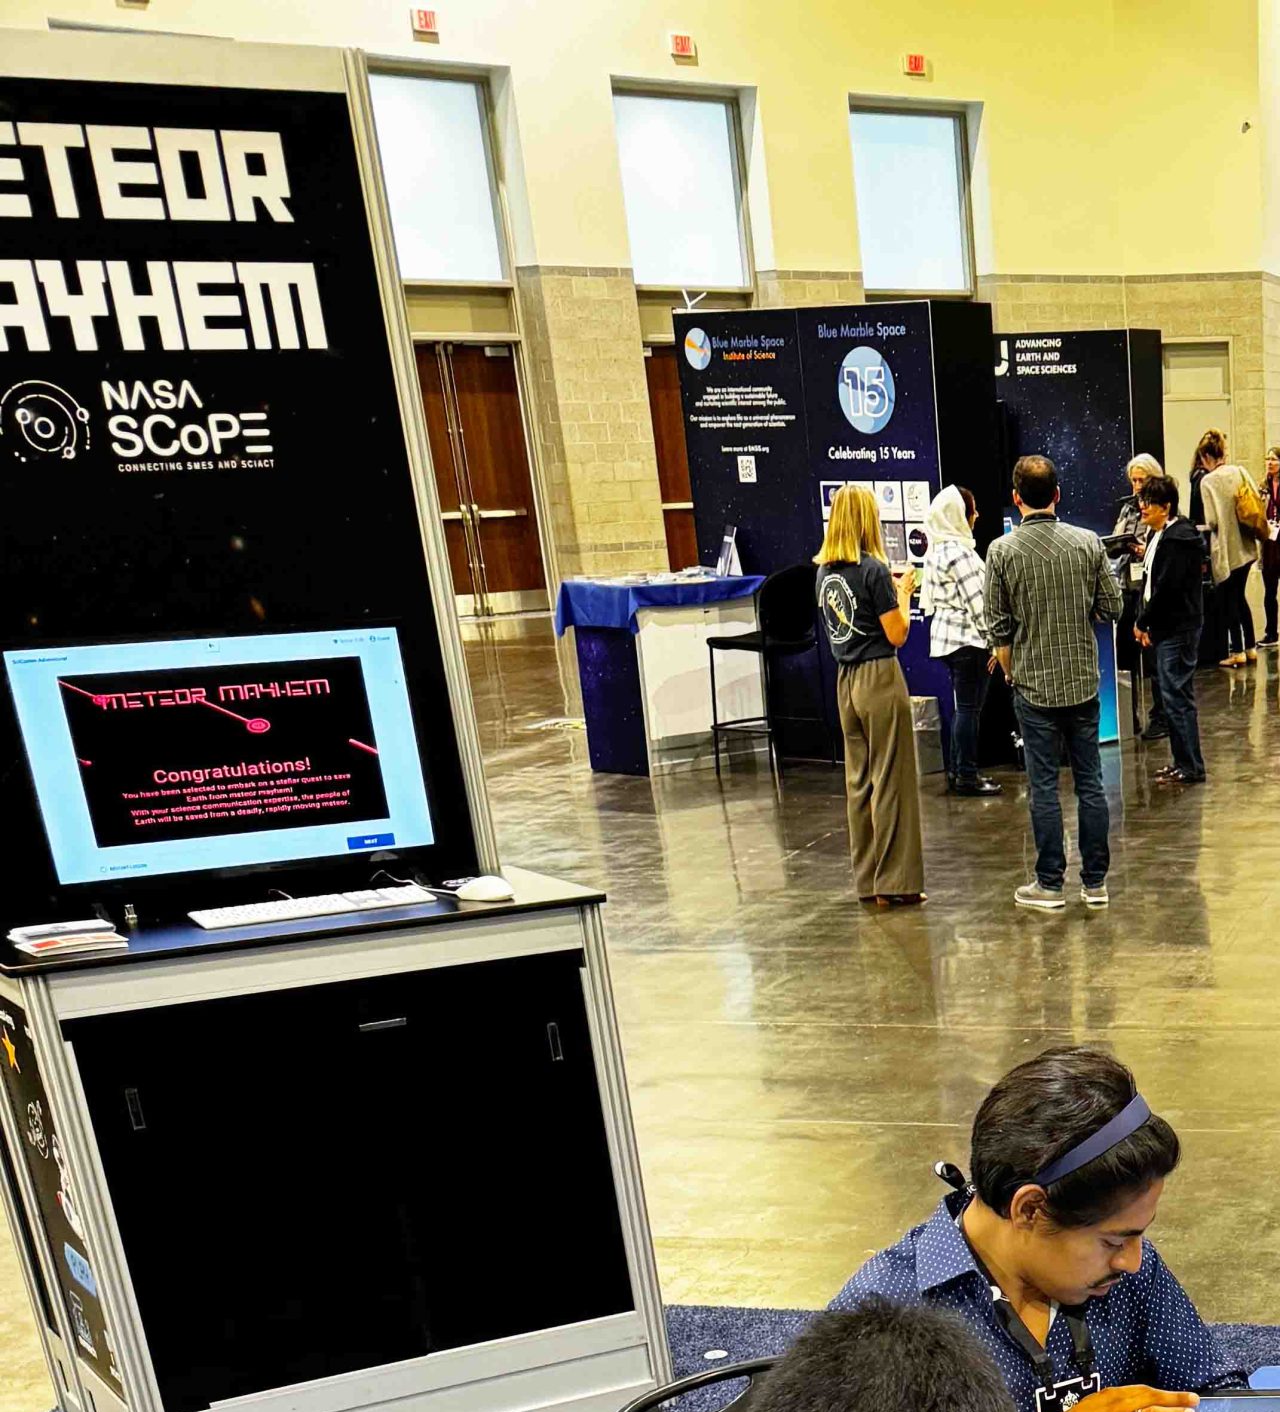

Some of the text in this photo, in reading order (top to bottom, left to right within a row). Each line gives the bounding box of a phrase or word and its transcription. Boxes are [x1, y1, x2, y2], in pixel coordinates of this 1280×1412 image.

[417, 10, 436, 29] EXIT
[674, 35, 692, 53] EXIT
[818, 322, 906, 340] Blue Marble Space
[712, 334, 784, 349] Blue Marble Space
[1016, 338, 1062, 349] ADVANCING
[723, 350, 775, 360] Institute of Science
[1016, 352, 1060, 362] EARTH AND
[1017, 364, 1077, 375] SPACE SCIENCES
[101, 379, 203, 410] NASA
[844, 366, 888, 417] 15
[108, 413, 273, 457] SCoPE
[828, 446, 915, 463] Celebrating 15 Years
[118, 459, 274, 472] CONNECTING SMES AND SCIACT
[101, 679, 331, 711] METEOR MAYHEM
[153, 757, 312, 784] Congratulations!
